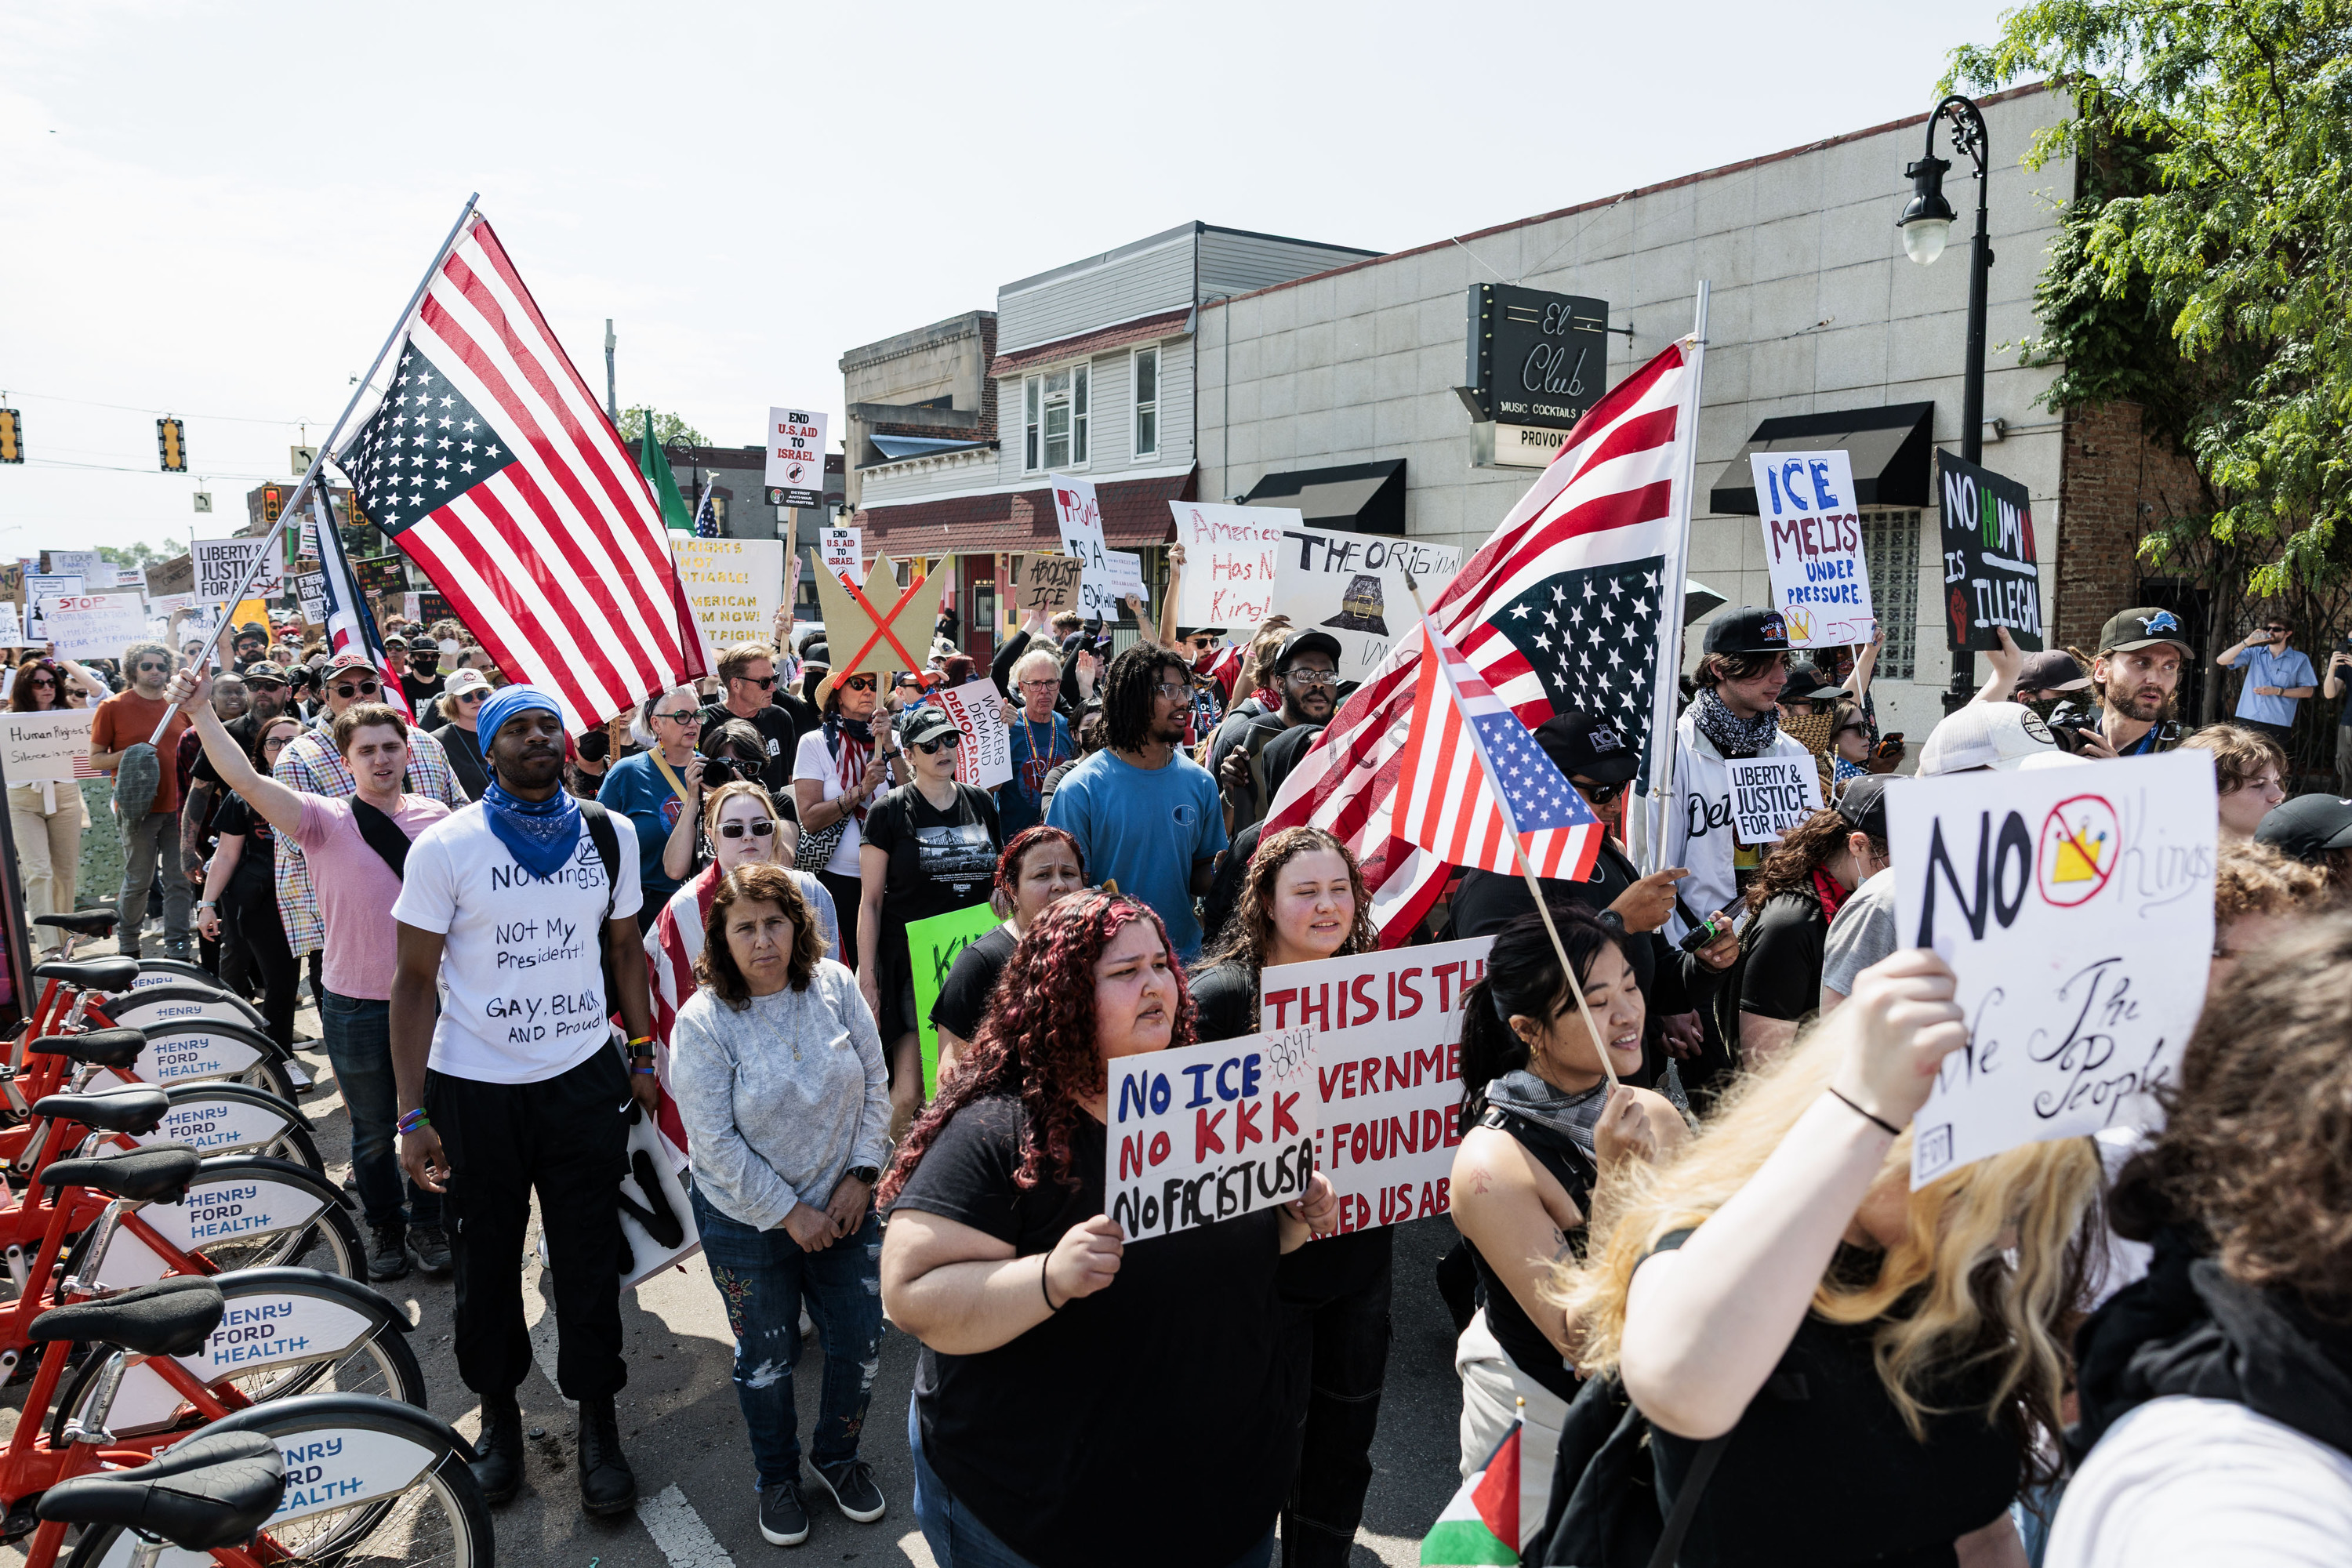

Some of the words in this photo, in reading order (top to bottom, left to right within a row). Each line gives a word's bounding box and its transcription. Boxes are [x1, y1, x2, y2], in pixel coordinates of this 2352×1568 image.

[1543, 303, 1571, 335] El
[1523, 343, 1587, 396] Club
[789, 412, 809, 424] END
[1501, 401, 1528, 414] MUSIC
[1533, 404, 1576, 419] COCKTAILS
[779, 423, 797, 435] U.S.
[800, 426, 818, 437] AID
[791, 437, 804, 448] TO
[778, 448, 815, 462] ISRAEL
[1768, 459, 1838, 514] ICE
[1058, 489, 1098, 528] TRUMP
[1945, 470, 1977, 532] NO
[1981, 486, 2036, 562] HUMAN
[688, 541, 742, 554] RIGHTS
[1771, 514, 1857, 564] MELTS
[200, 544, 252, 561] LIBERTY
[681, 557, 713, 568] NOT
[1094, 539, 1106, 571] A
[1030, 558, 1081, 589] ABOLISH
[1213, 553, 1252, 581] Has
[1260, 550, 1276, 579] N
[1806, 560, 1853, 583] UNDER
[1944, 550, 1965, 583] IS
[202, 582, 228, 597] FOR
[1029, 587, 1068, 610] ICE
[1788, 584, 1862, 604] PRESSURE.
[59, 597, 106, 609] STOP
[1211, 588, 1270, 622] King!
[1972, 578, 2042, 637] ILLEGAL
[720, 612, 760, 622] NOW!
[64, 638, 89, 649] FEAR
[103, 633, 148, 644] TRAUMA
[720, 630, 771, 642] FIGHT!
[1828, 618, 1873, 644] FDT
[10, 727, 52, 742] Human
[53, 725, 84, 741] Rights
[944, 691, 981, 787] DEMOCRACY
[968, 702, 991, 766] DEMAND
[982, 695, 1004, 766] WORKERS
[11, 750, 51, 764] Silence
[1733, 765, 1785, 786] LIBERTY
[1790, 764, 1802, 783] &
[1737, 784, 1809, 815] JUSTICE
[1740, 815, 1772, 836] FOR
[492, 865, 529, 891] NO
[1918, 810, 2032, 948] NO
[547, 917, 576, 947] My
[497, 941, 584, 969] President!
[131, 977, 172, 988] HENRY
[157, 1006, 201, 1016] HENRY
[1265, 975, 1379, 1033] THIS
[1387, 967, 1423, 1022] IS
[2027, 956, 2140, 1063] The
[509, 1025, 545, 1044] AND
[556, 1010, 603, 1038] Proud!
[154, 1039, 209, 1054] HENRY
[158, 1052, 198, 1065] FORD
[158, 1061, 220, 1077] HEALTH
[1119, 1070, 1171, 1123] NO
[1182, 1054, 1261, 1109] ICE
[1270, 1029, 1312, 1077] 8647
[165, 1106, 227, 1125] HENRY
[170, 1122, 215, 1138] FORD
[177, 1131, 241, 1148] EALTH
[1120, 1130, 1171, 1181] NO
[1258, 1138, 1313, 1200] USA
[186, 1186, 256, 1207] HENRY
[1379, 1183, 1413, 1225] US
[191, 1204, 242, 1223] FORD
[191, 1214, 271, 1239] HEALTH
[213, 1324, 275, 1347] FORD
[214, 1336, 310, 1365] HEALTH
[285, 1437, 342, 1466] NRY
